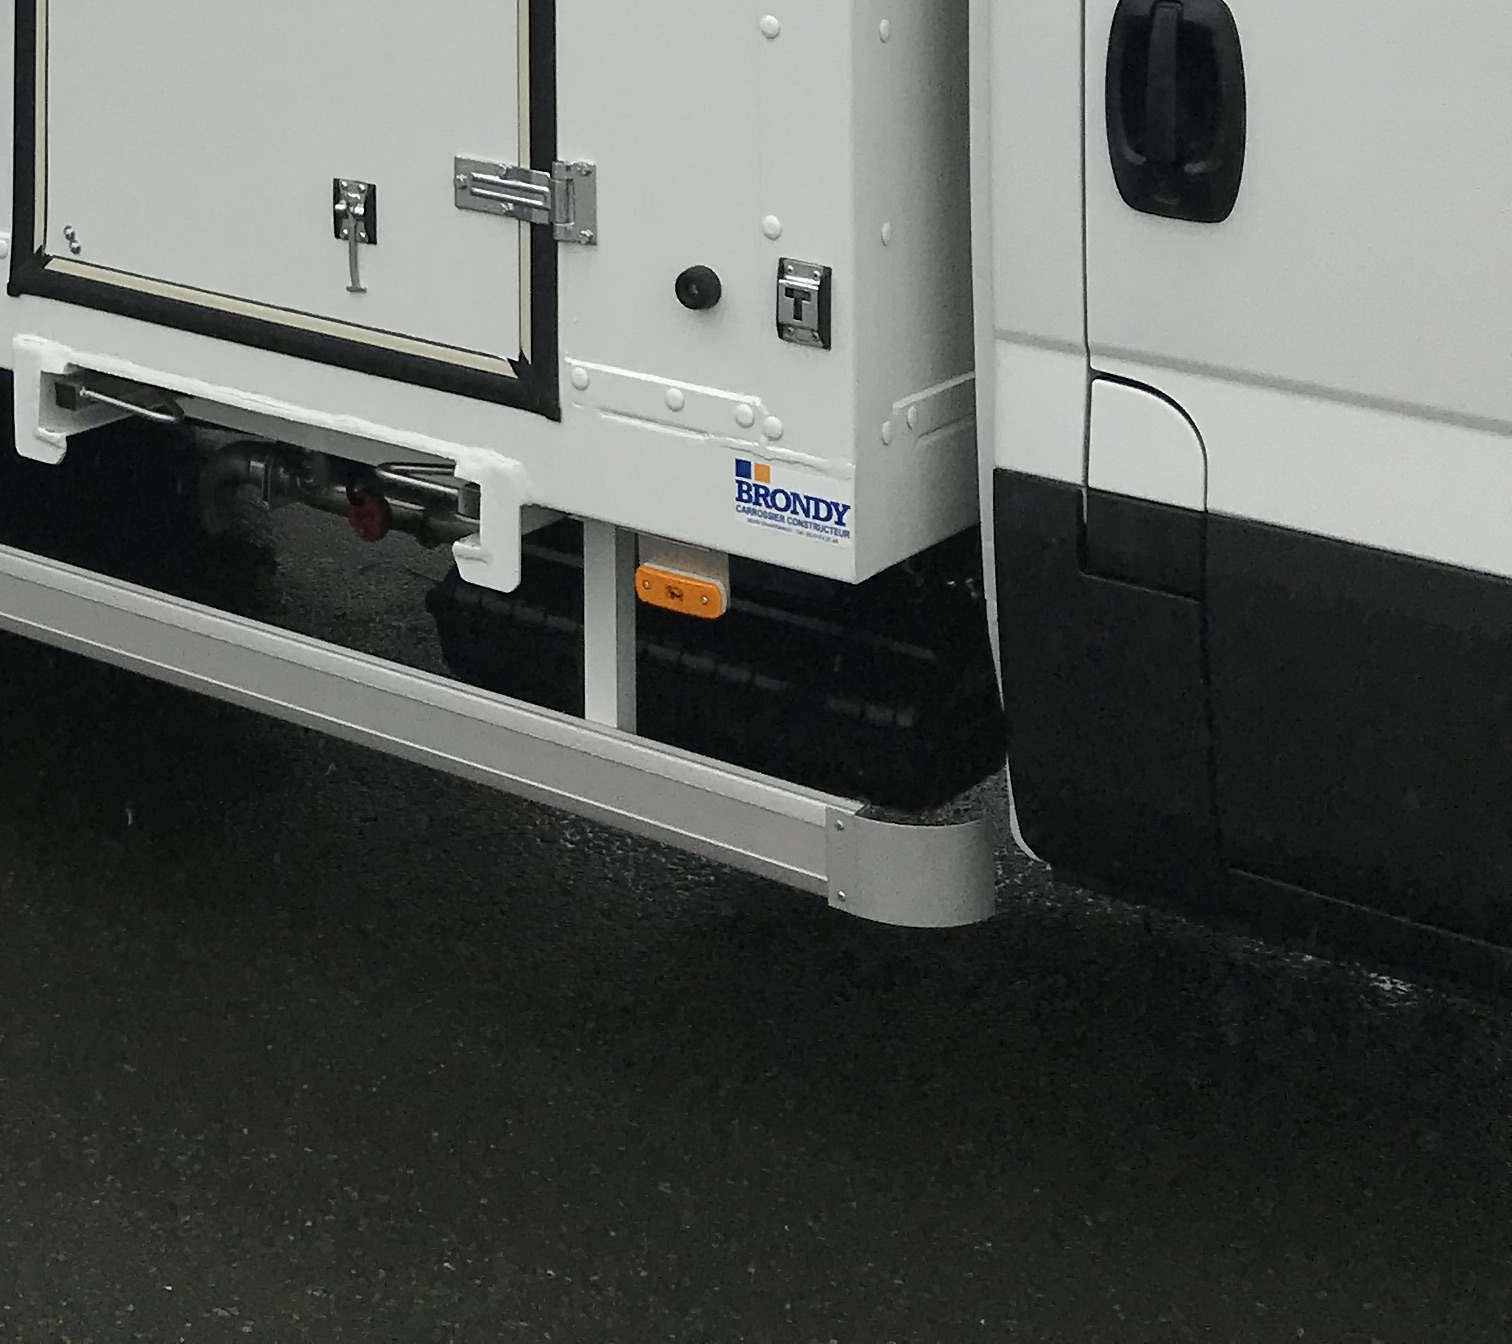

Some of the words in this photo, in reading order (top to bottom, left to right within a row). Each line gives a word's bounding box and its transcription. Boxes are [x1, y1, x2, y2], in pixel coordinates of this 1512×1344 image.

[735, 478, 851, 527] BRONDY
[735, 504, 786, 525] CARROSSIER
[787, 516, 850, 540] CONSTRUCTEUR
